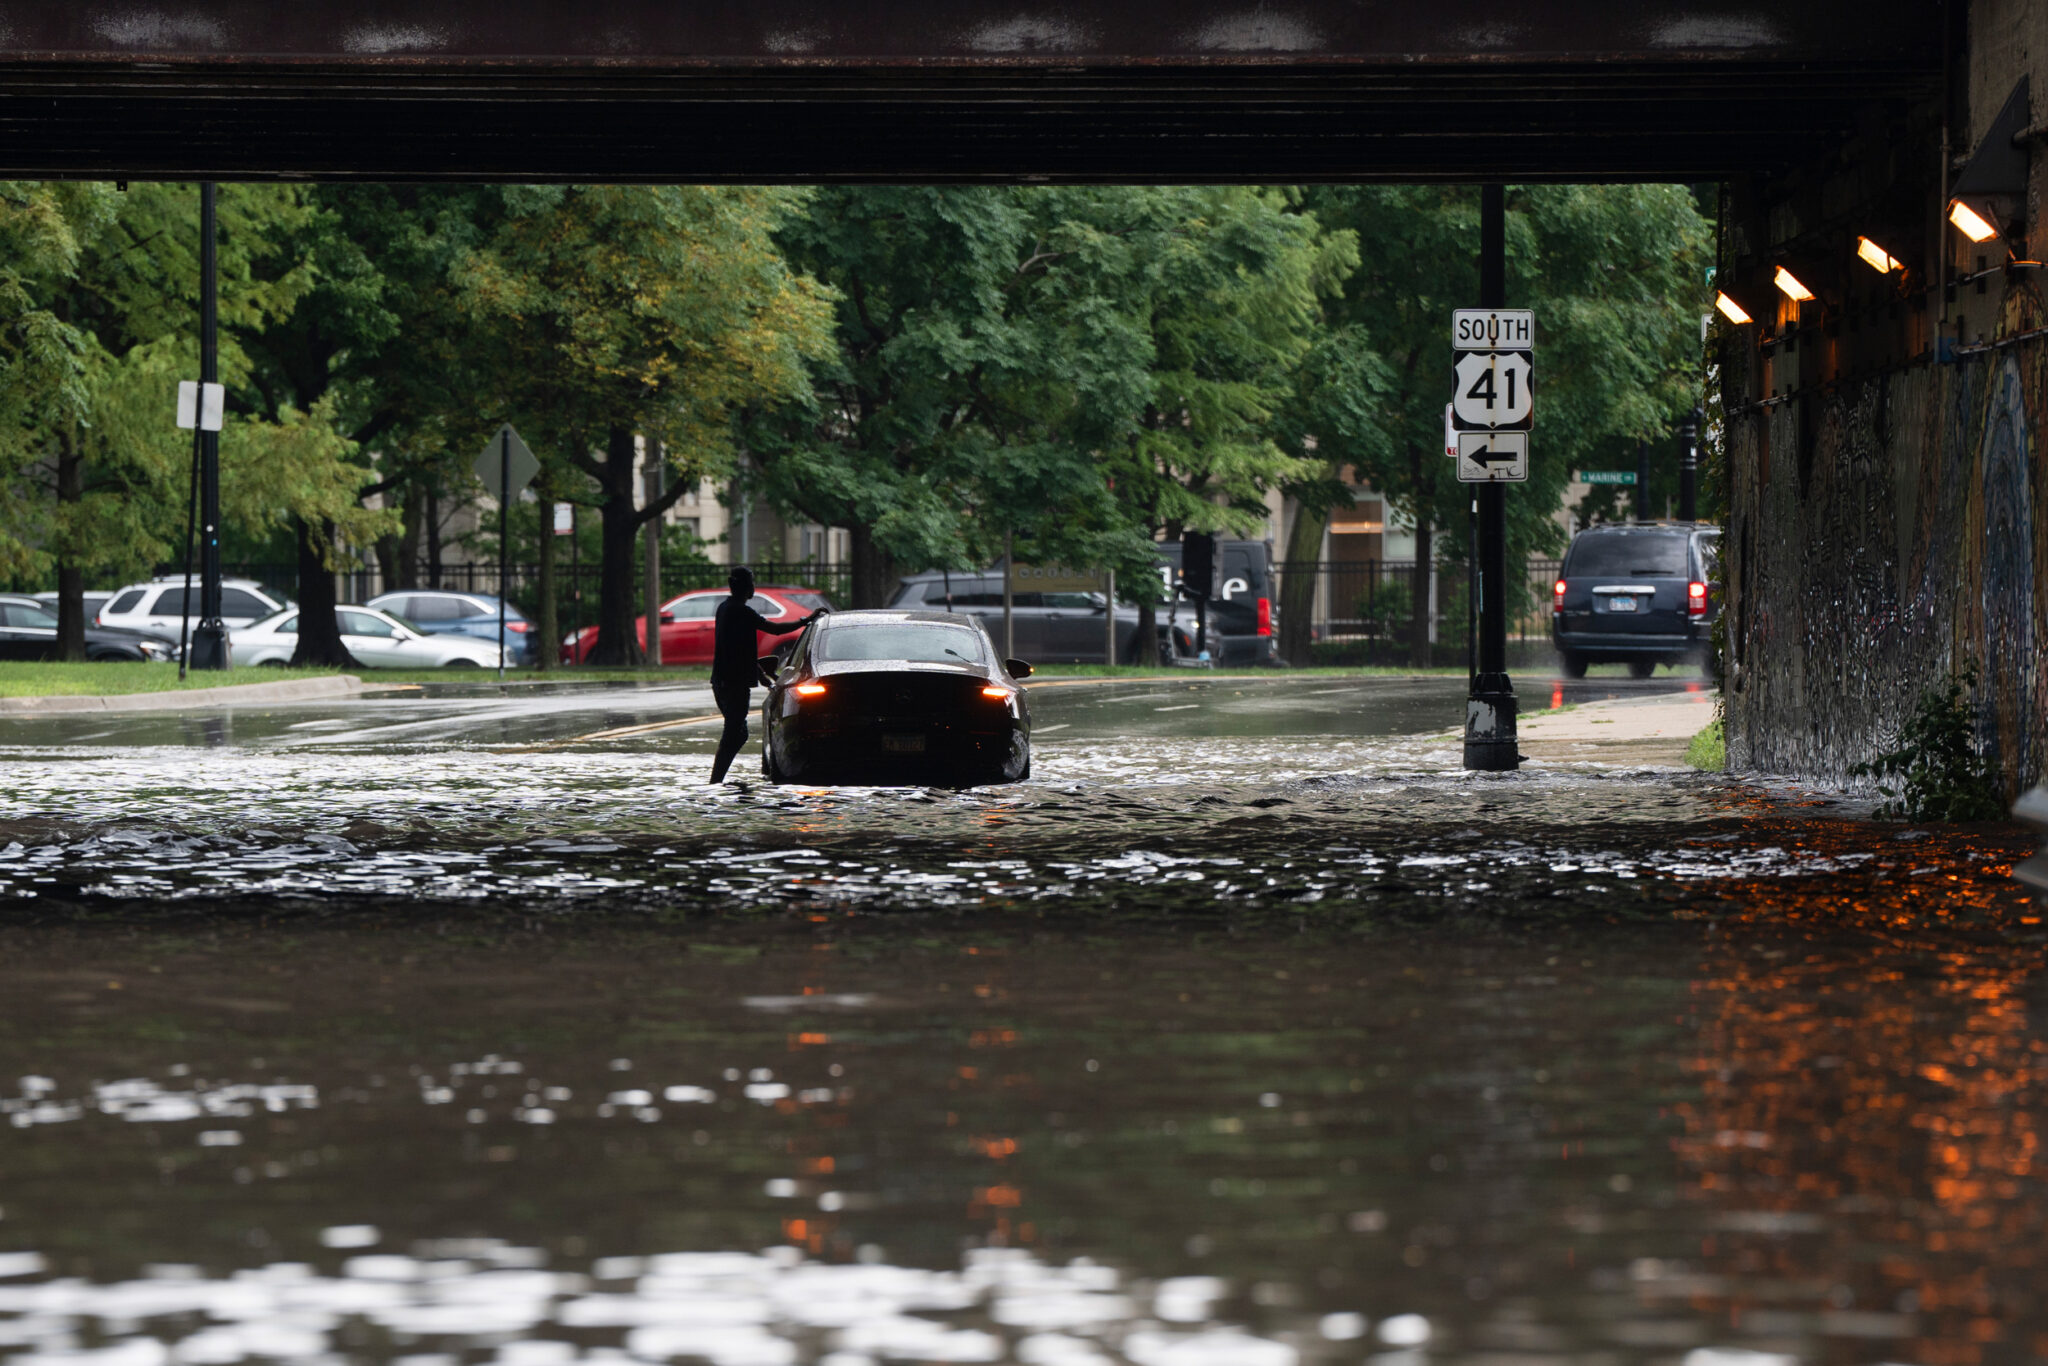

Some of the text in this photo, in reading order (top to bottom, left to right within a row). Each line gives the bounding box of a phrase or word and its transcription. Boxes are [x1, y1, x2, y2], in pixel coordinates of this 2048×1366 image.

[1458, 318, 1529, 341] SOUTH
[1466, 368, 1516, 410] 41
[1588, 471, 1623, 484] MARINE
